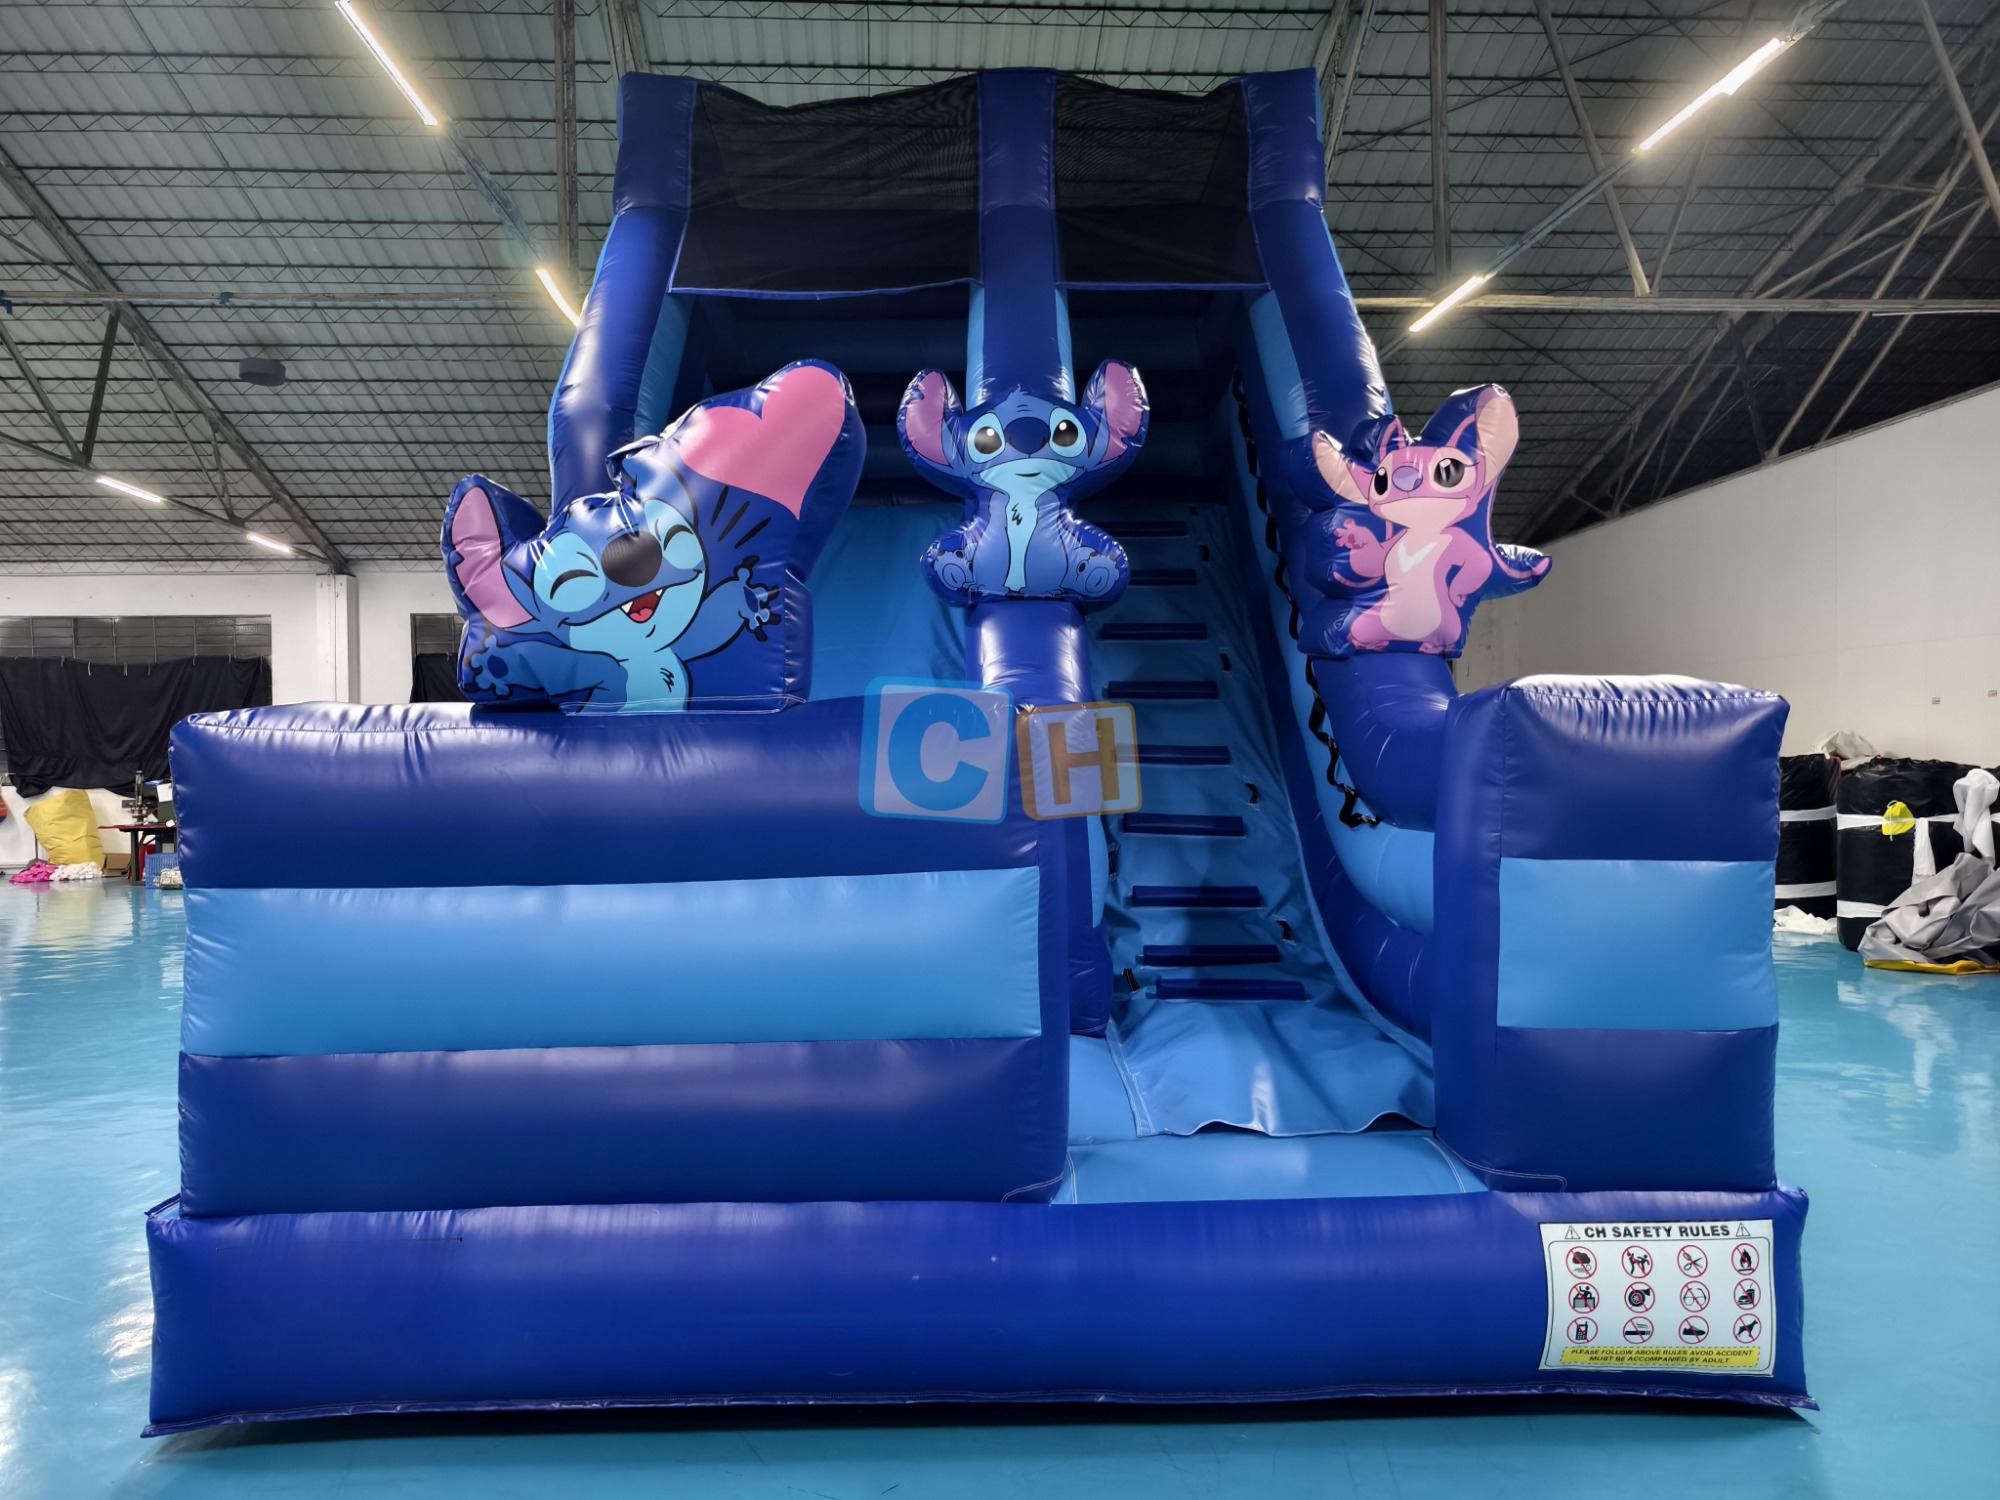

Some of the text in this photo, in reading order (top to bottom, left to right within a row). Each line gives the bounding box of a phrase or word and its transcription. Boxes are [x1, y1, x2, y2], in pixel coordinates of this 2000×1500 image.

[1584, 1225, 1730, 1238] CH SAFETY RULES
